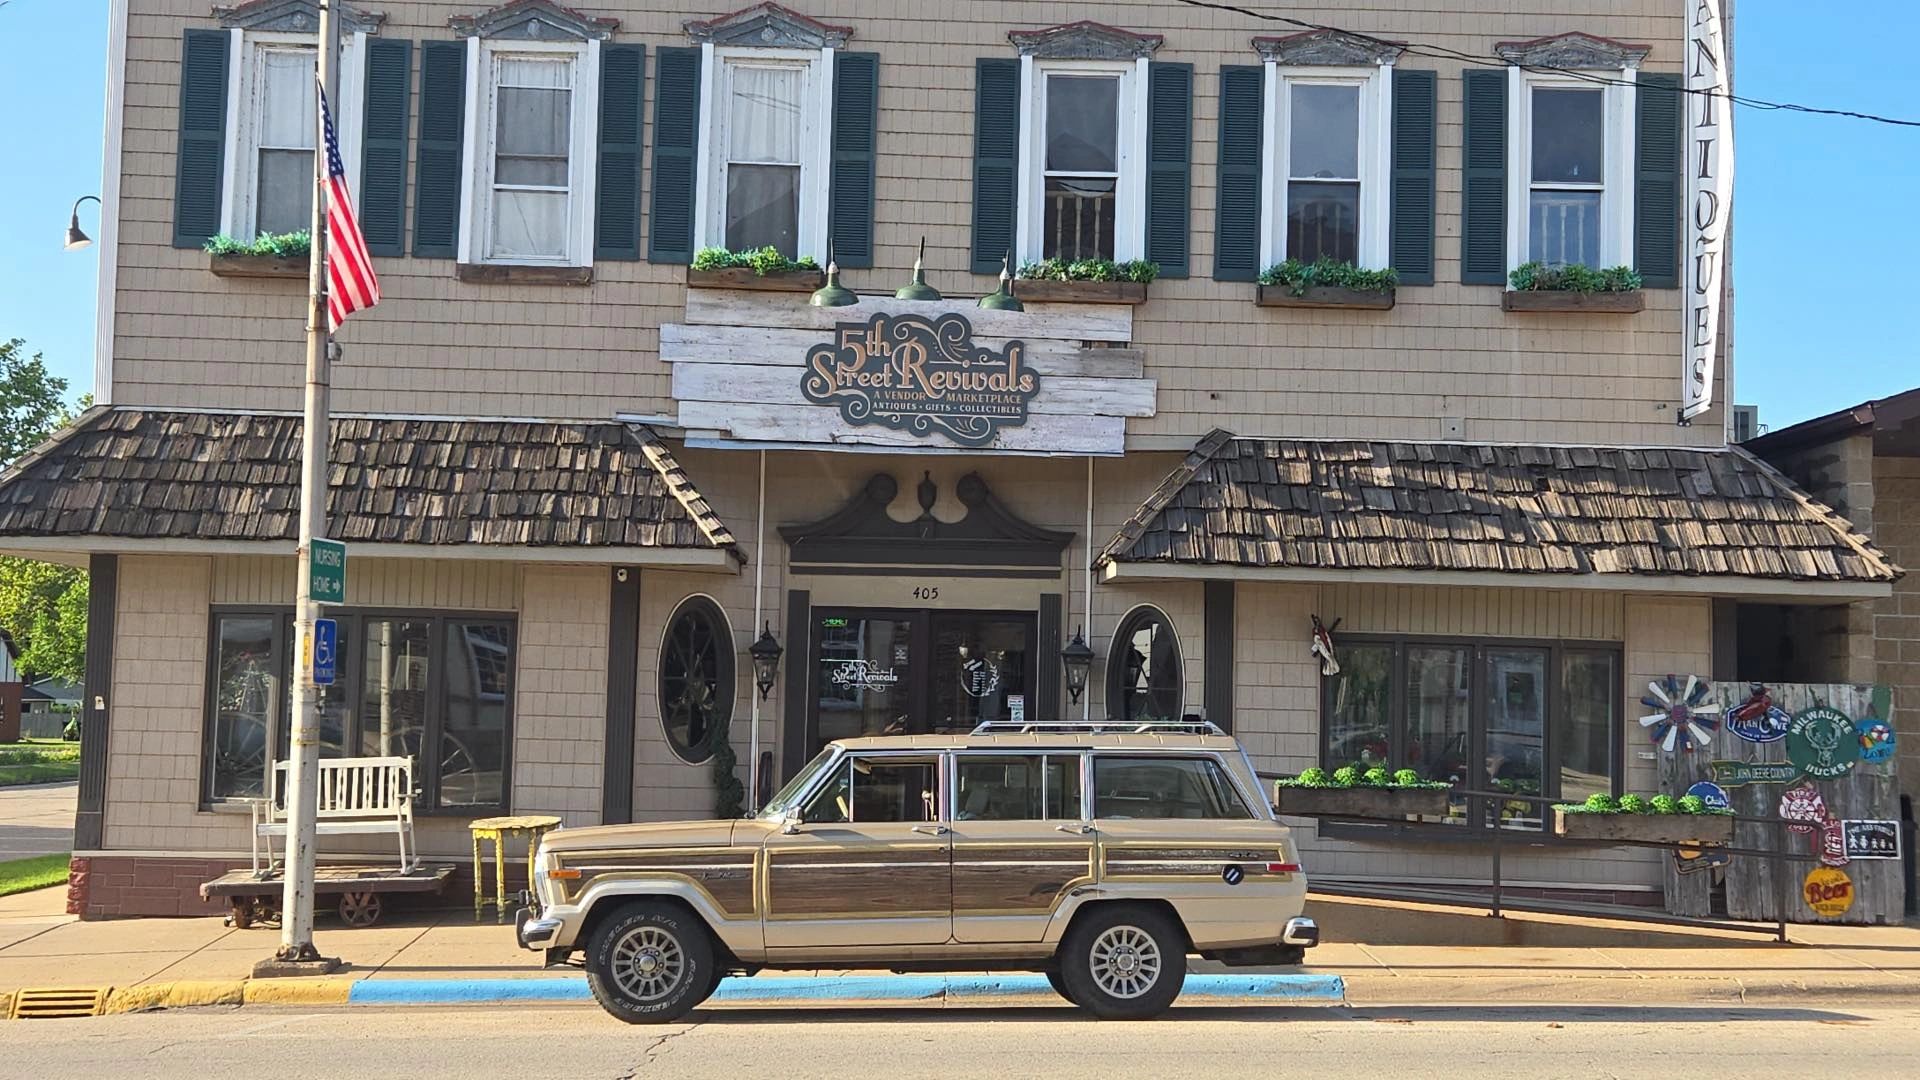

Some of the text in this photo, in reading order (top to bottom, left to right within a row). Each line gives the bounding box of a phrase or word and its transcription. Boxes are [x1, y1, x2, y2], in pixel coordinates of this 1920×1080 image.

[1690, 0, 1722, 399] ANTIQUES
[842, 320, 892, 372] 5th
[807, 336, 1034, 399] Street Revivals
[873, 390, 1021, 404] A VENDOR MARKETPLACE
[872, 402, 1021, 414] ANTIQUES GIFTS COLLECTIBLES
[315, 548, 341, 568] NURSING
[313, 576, 330, 593] HOME
[913, 587, 939, 600] 405
[1791, 710, 1854, 735] MILWAUKEE
[1770, 767, 1795, 779] COUNTRY
[1805, 762, 1846, 776] BUCKS
[1806, 882, 1850, 904] Beer
